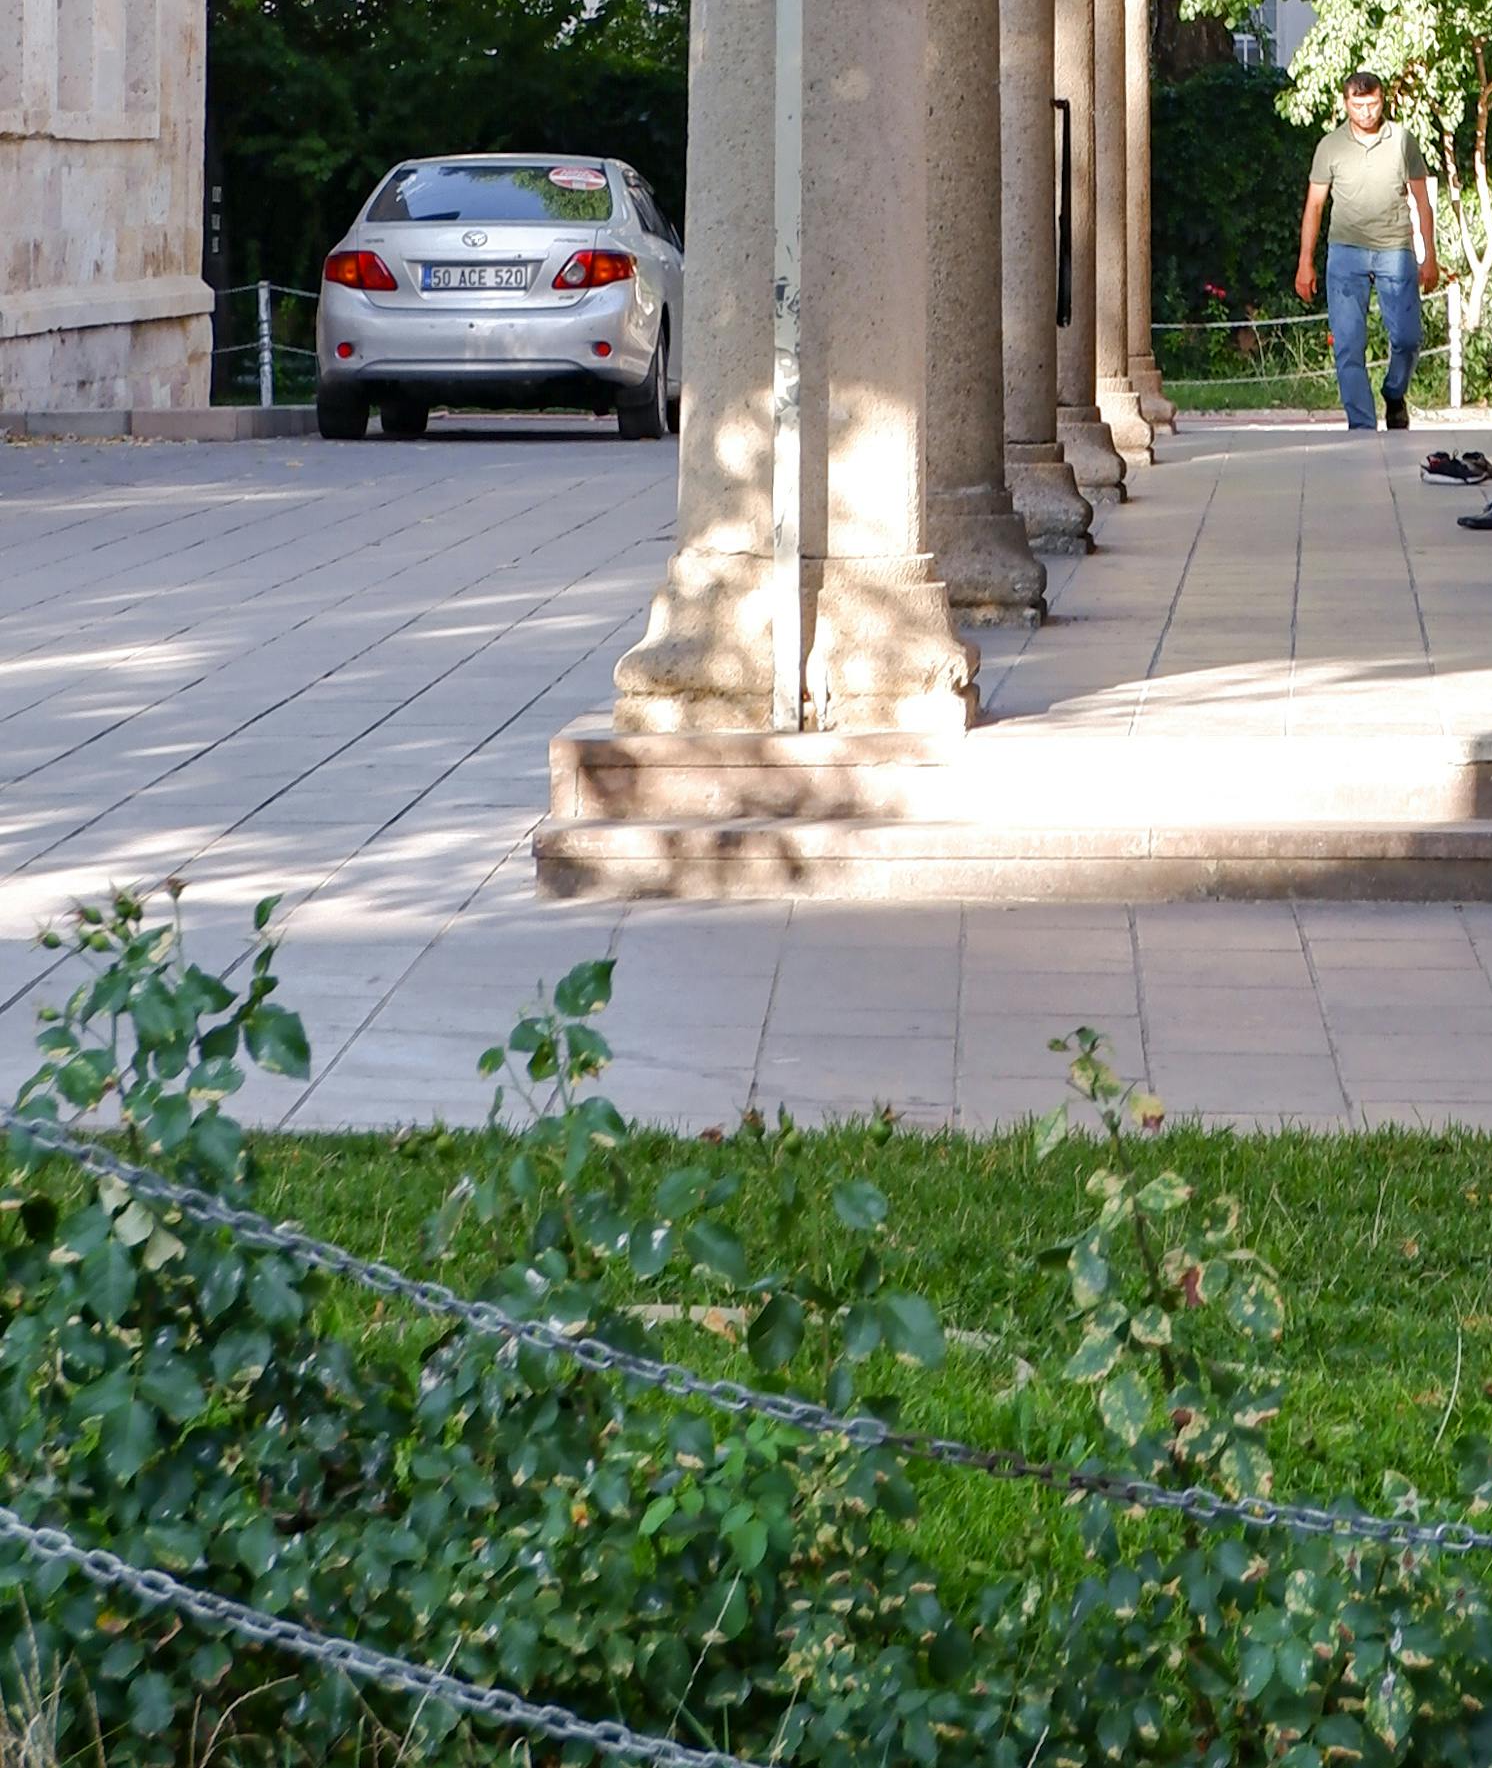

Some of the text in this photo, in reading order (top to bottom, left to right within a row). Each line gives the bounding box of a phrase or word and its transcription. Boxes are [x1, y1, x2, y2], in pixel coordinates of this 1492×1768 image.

[433, 268, 523, 286] 50 ACE 520
